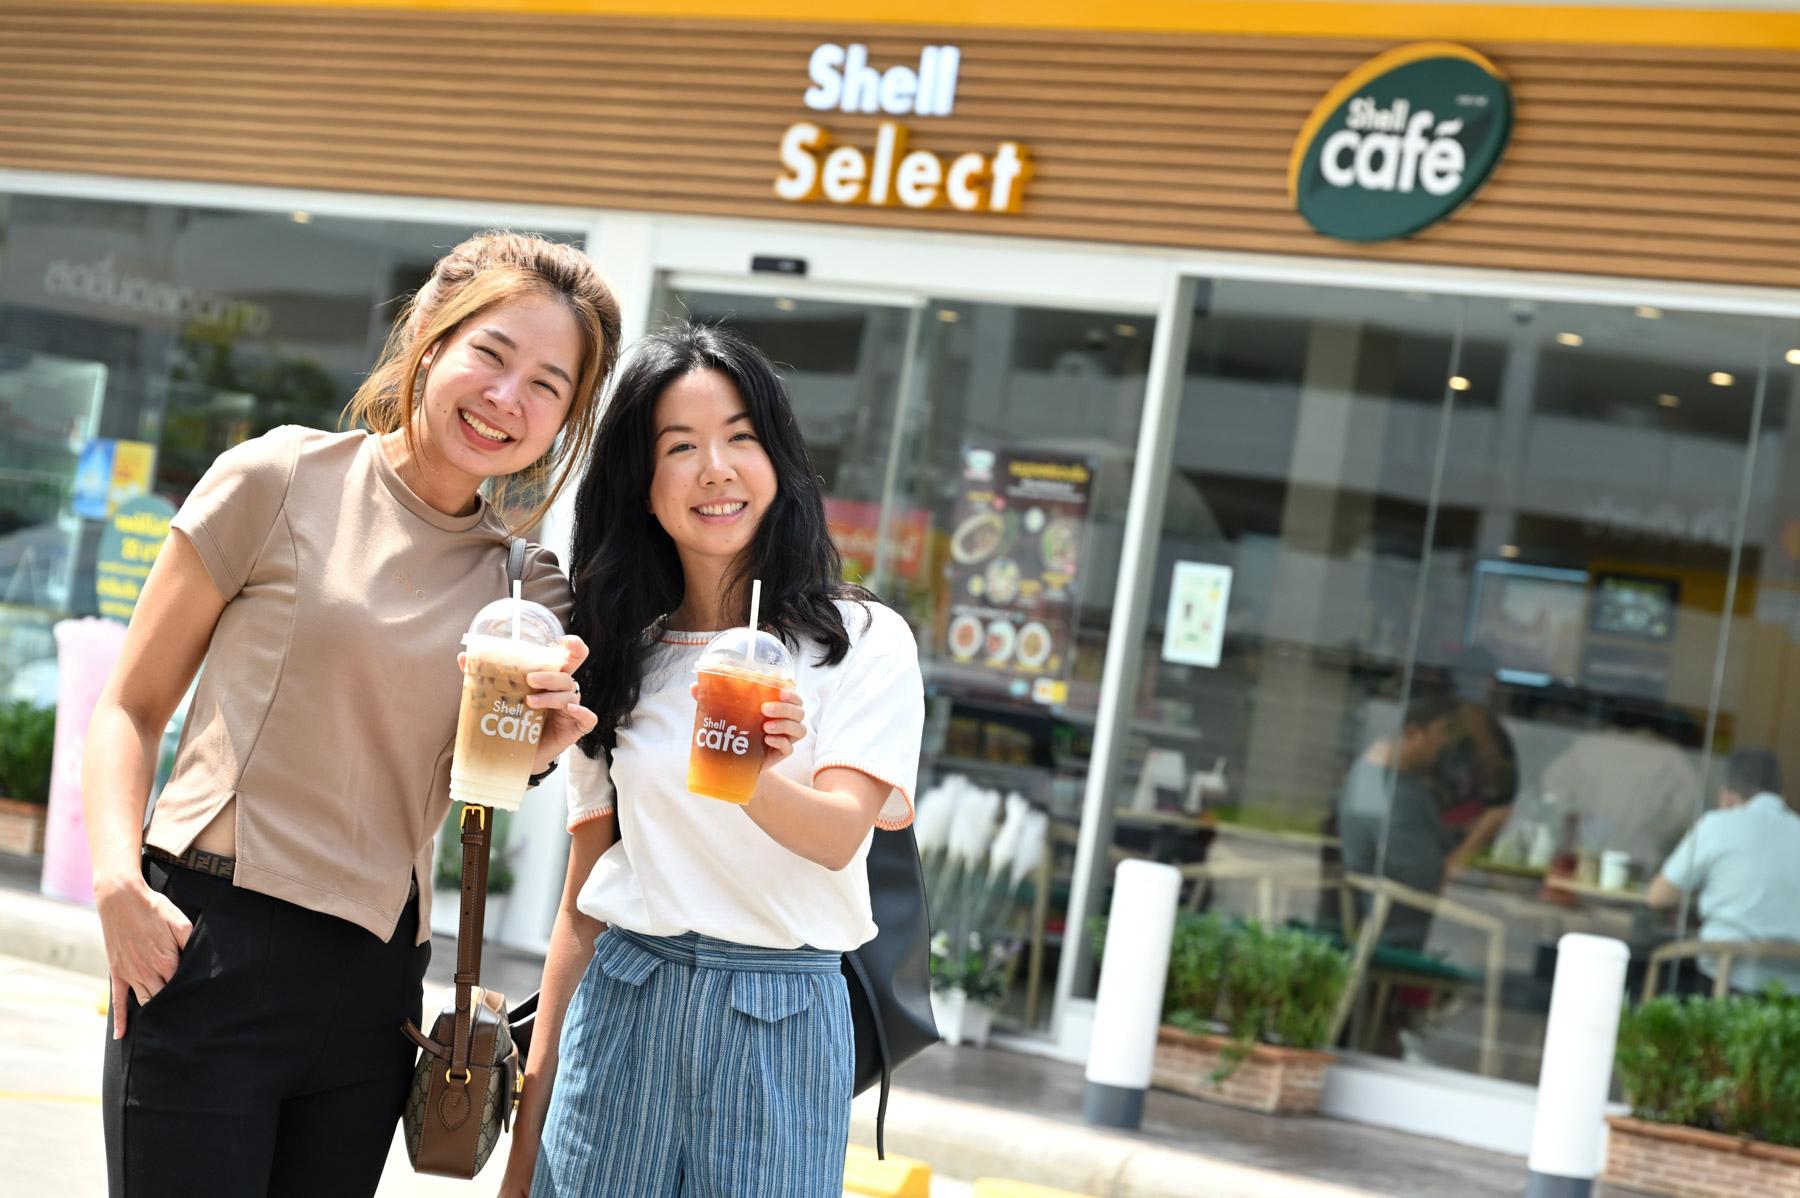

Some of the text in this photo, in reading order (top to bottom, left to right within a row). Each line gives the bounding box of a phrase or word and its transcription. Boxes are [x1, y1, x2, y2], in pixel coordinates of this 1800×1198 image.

[804, 43, 960, 116] Shell
[1346, 97, 1410, 132] Shell
[774, 122, 1024, 212] Select
[1320, 110, 1466, 196] café
[493, 700, 524, 716] Shell
[703, 717, 726, 730] Shell
[480, 710, 543, 744] café
[696, 725, 750, 755] café
